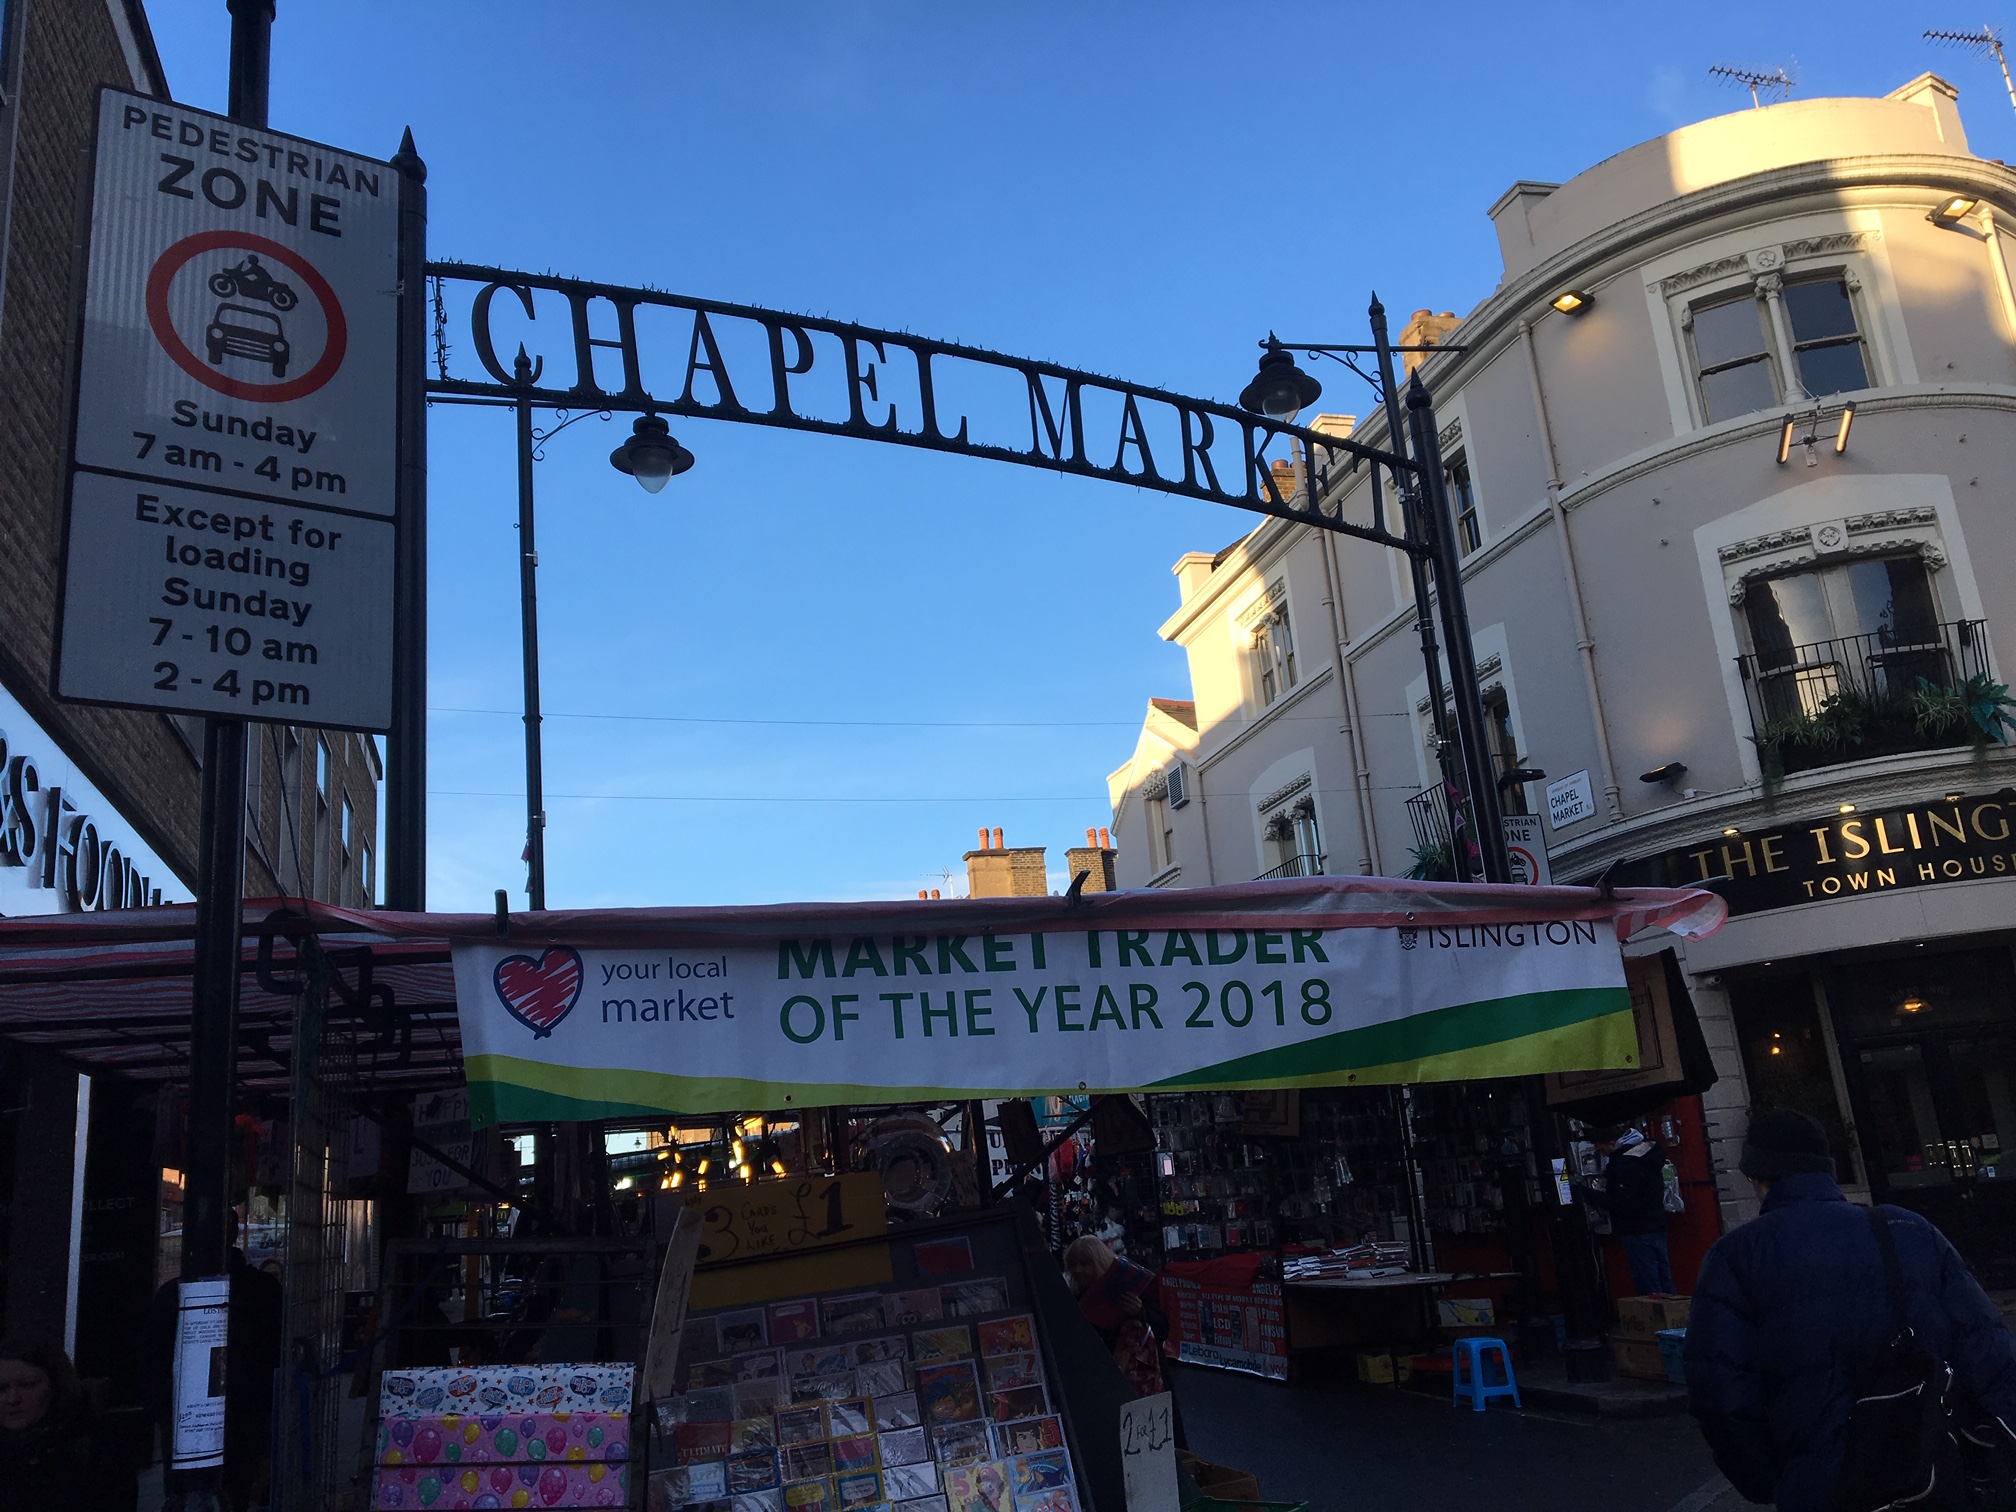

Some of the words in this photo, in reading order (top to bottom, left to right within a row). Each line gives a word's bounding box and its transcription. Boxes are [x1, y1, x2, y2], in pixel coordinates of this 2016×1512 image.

[123, 104, 380, 198] PEDESTRIAN
[157, 152, 343, 238] ZONE
[170, 399, 317, 454] Sunday
[471, 280, 969, 443] CHAPEL
[1018, 366, 1400, 538] MARKET
[135, 493, 274, 542] Except
[288, 519, 342, 551] for
[165, 535, 310, 587] loading
[161, 577, 312, 628] Sunday
[1550, 788, 1579, 809] CHAPEL
[1552, 801, 1584, 824] MARKET
[1503, 818, 1537, 827] STRIAN
[1688, 834, 1791, 882] THE
[1809, 800, 2016, 866] ISLING
[1802, 867, 1898, 898] TOWN
[777, 931, 1048, 980] MARKET
[1086, 928, 1331, 969] TRADER
[1428, 920, 1597, 949] ISLINGTON
[600, 960, 661, 987] your
[667, 955, 728, 979] local
[601, 988, 735, 1023] market
[779, 993, 860, 1045] OF
[879, 988, 996, 1040] THE
[1012, 983, 1164, 1034] YEAR
[1182, 978, 1333, 1029] 2018
[417, 1097, 471, 1122] HPPY
[697, 1204, 740, 1262] 3
[1213, 1317, 1231, 1330] LCD
[1188, 1343, 1219, 1360] Lebara
[681, 1444, 728, 1459] ULTIMATE
